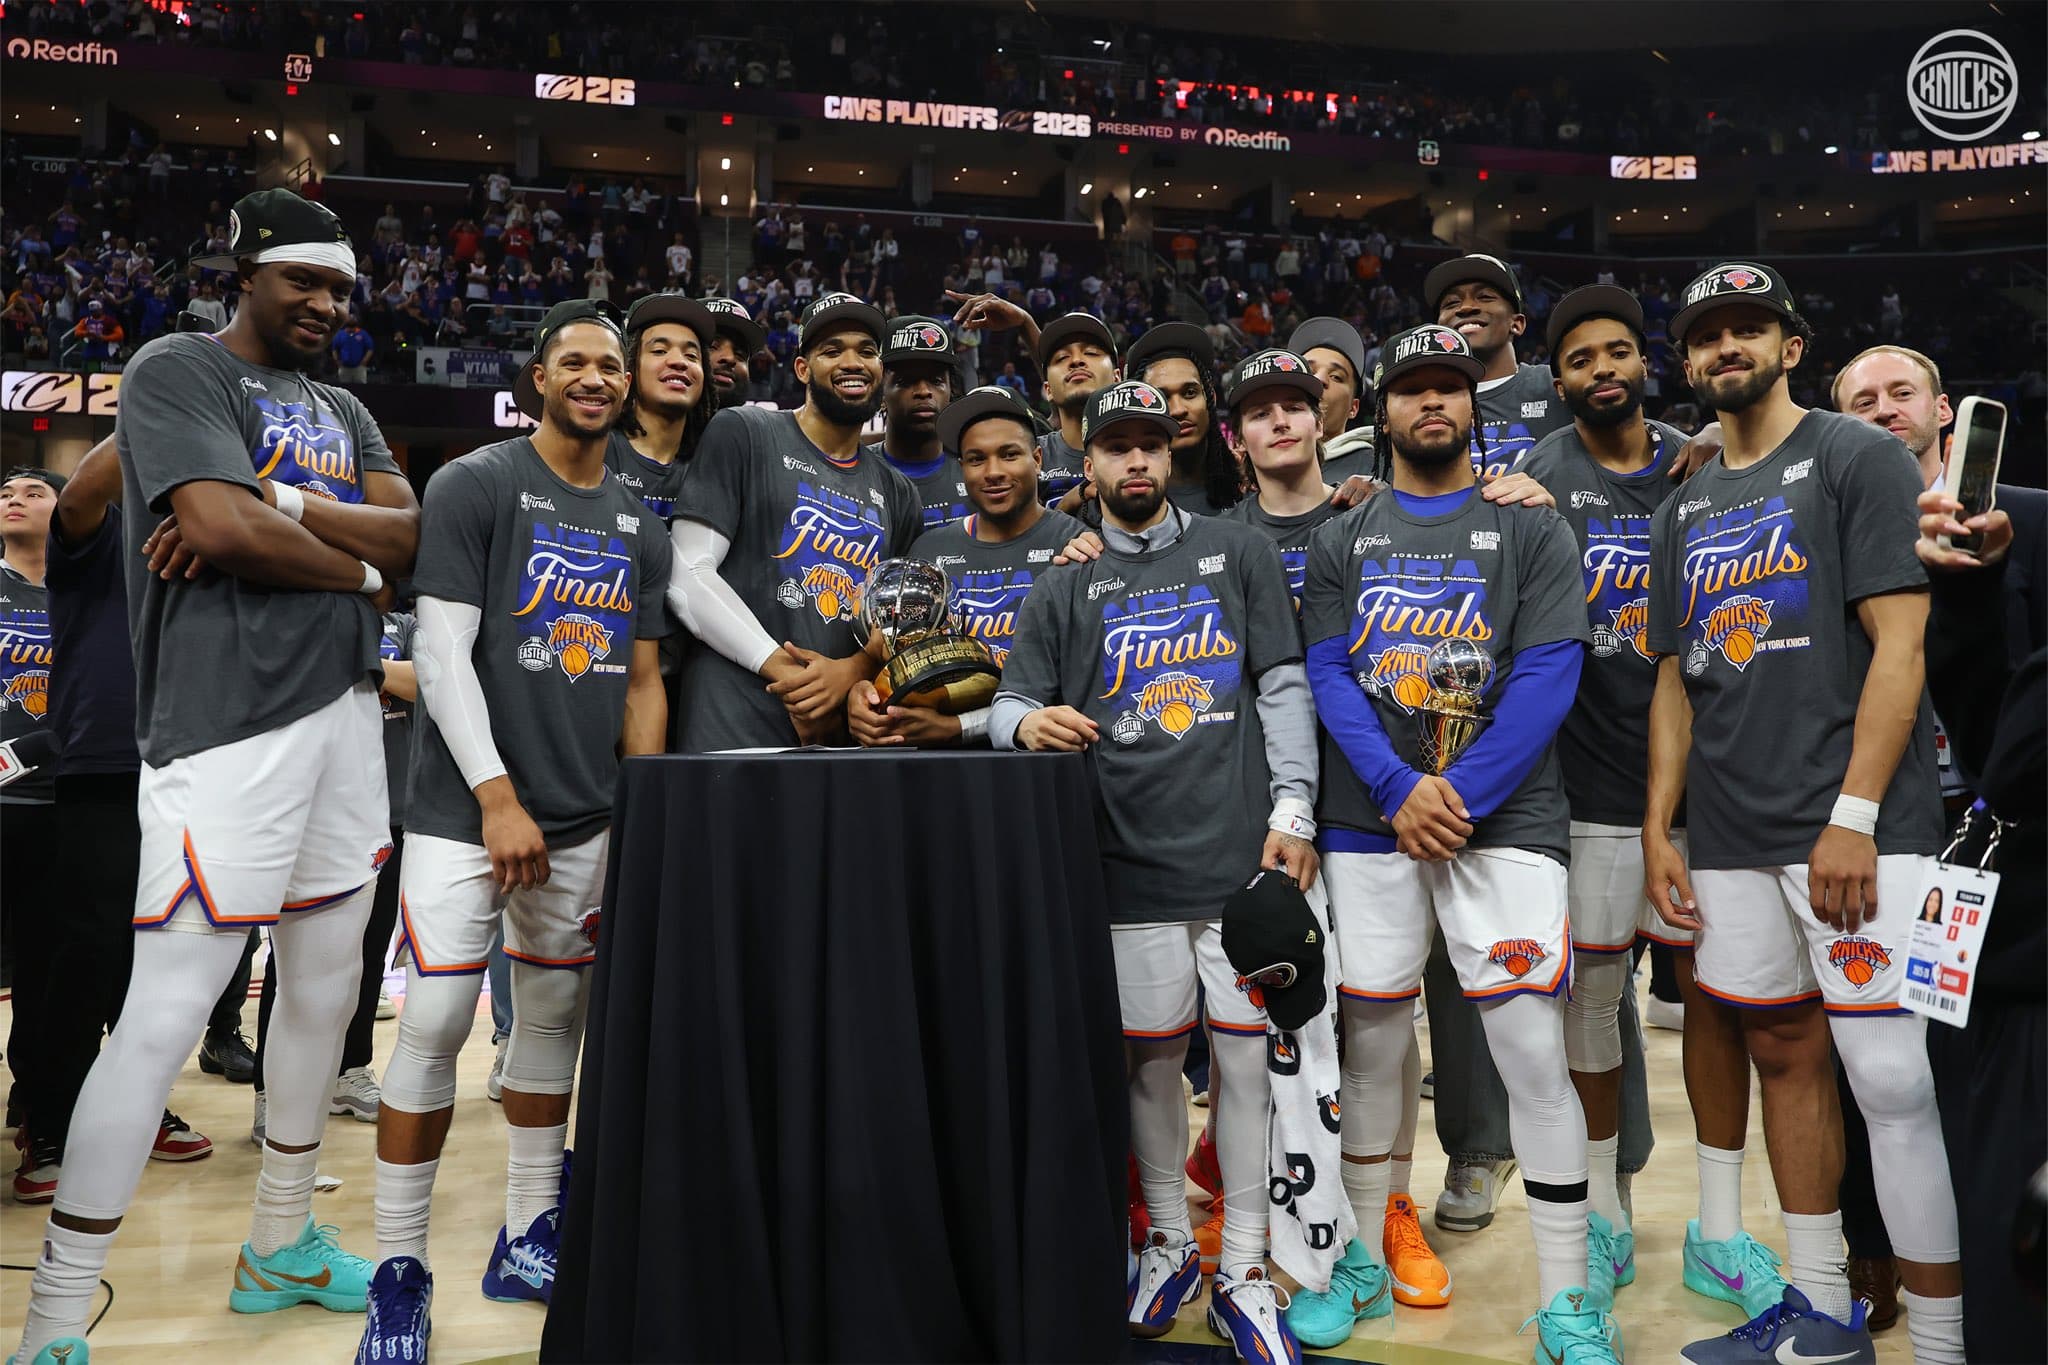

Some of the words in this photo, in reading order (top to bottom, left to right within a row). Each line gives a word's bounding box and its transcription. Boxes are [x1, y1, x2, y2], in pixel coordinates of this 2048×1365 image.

[33, 39, 118, 66] Redfin
[585, 76, 635, 106] 26
[824, 95, 882, 122] CAVS
[886, 100, 998, 131] PLAYOFFS
[1032, 111, 1092, 138] 2026
[1097, 122, 1174, 139] PRESENTED
[1180, 128, 1199, 140] BY
[1224, 128, 1291, 151] Redfin
[1652, 156, 1697, 180] 26
[1932, 140, 2048, 172] PLAYOFFS
[891, 333, 919, 350] FINALS
[1395, 336, 1431, 363] FINALS
[464, 361, 500, 377] WTAM
[1242, 361, 1272, 382] FINALS
[1098, 392, 1131, 417] FINALS
[256, 424, 356, 485] Finals
[528, 495, 556, 512] Finals
[1581, 491, 1609, 510] Finals
[1688, 495, 1711, 516] Finals
[770, 505, 880, 571] Finals
[510, 551, 633, 616] Finals
[804, 565, 854, 600] KNICKS
[1094, 576, 1126, 599] Finals
[1677, 524, 1808, 629] Finals
[1134, 606, 1179, 618] CONFERENCE
[1179, 598, 1220, 609] CHAMPIONS
[1348, 585, 1493, 655] Finals
[1708, 601, 1769, 639] KNICKS
[551, 619, 609, 651] KNICKS
[1594, 634, 1620, 648] STERN
[1767, 640, 1785, 651] YORK
[1785, 637, 1810, 650] KNICKS
[518, 646, 551, 667] EASTERN
[1098, 612, 1237, 700] Finals
[1140, 679, 1212, 713] KNICKS
[1113, 717, 1145, 737] EASTERN
[1197, 713, 1211, 724] NEW
[1211, 712, 1225, 723] YORK
[1488, 939, 1546, 961] KNICKS
[1829, 940, 1891, 965] KNICKS
